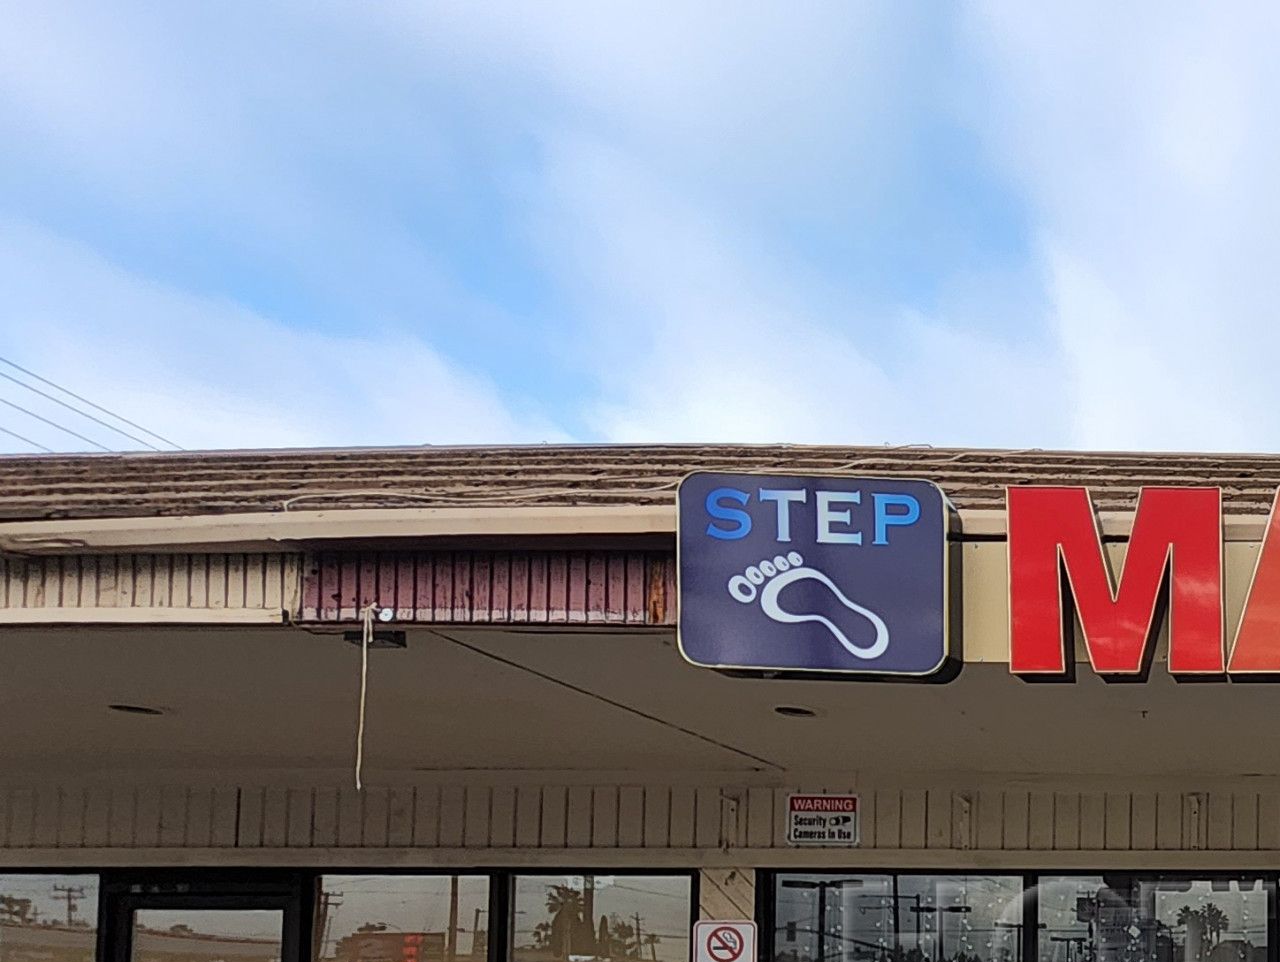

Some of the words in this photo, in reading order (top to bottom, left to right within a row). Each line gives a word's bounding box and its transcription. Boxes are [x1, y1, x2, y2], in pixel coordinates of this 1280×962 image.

[705, 487, 921, 545] STEP
[793, 799, 854, 811] WARNING
[794, 814, 827, 828] Security
[793, 828, 826, 839] Cameras
[837, 829, 851, 839] Use
